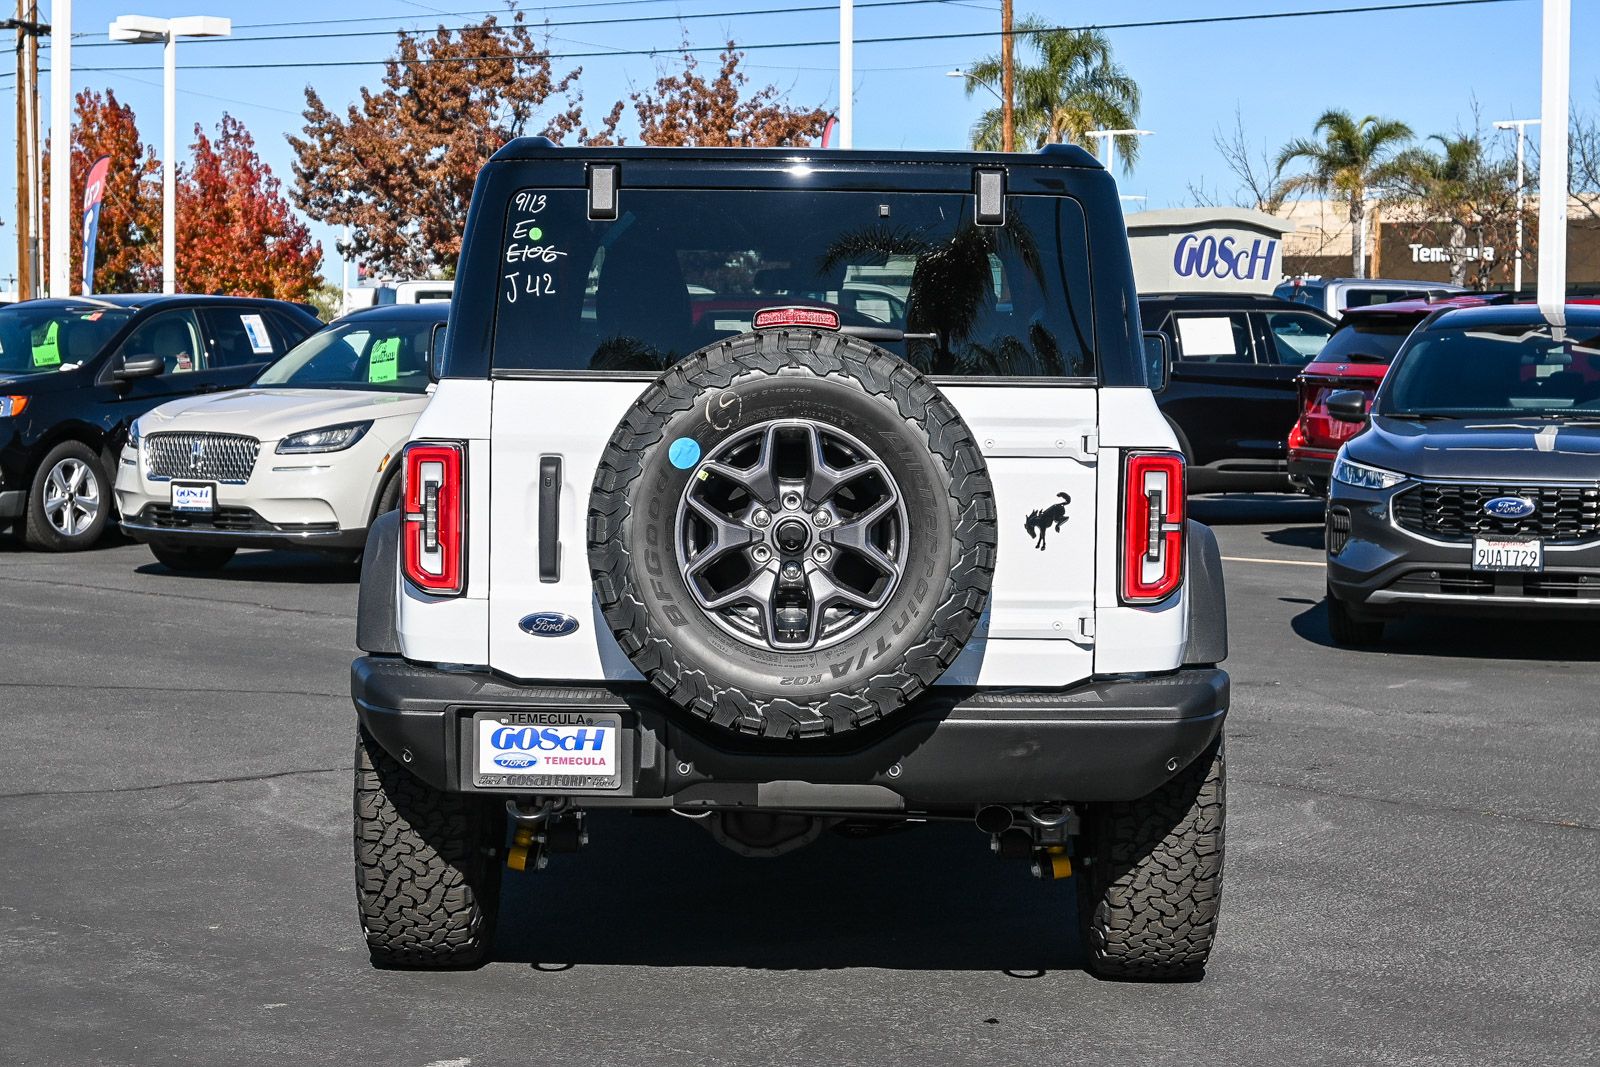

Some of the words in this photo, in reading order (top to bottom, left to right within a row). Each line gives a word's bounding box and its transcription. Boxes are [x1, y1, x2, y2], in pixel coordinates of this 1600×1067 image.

[1408, 243, 1495, 263] Temua
[1478, 549, 1538, 567] 9UAT729
[508, 713, 586, 725] TEMECULA
[544, 756, 606, 766] TEMECULA
[554, 775, 587, 786] FORD
